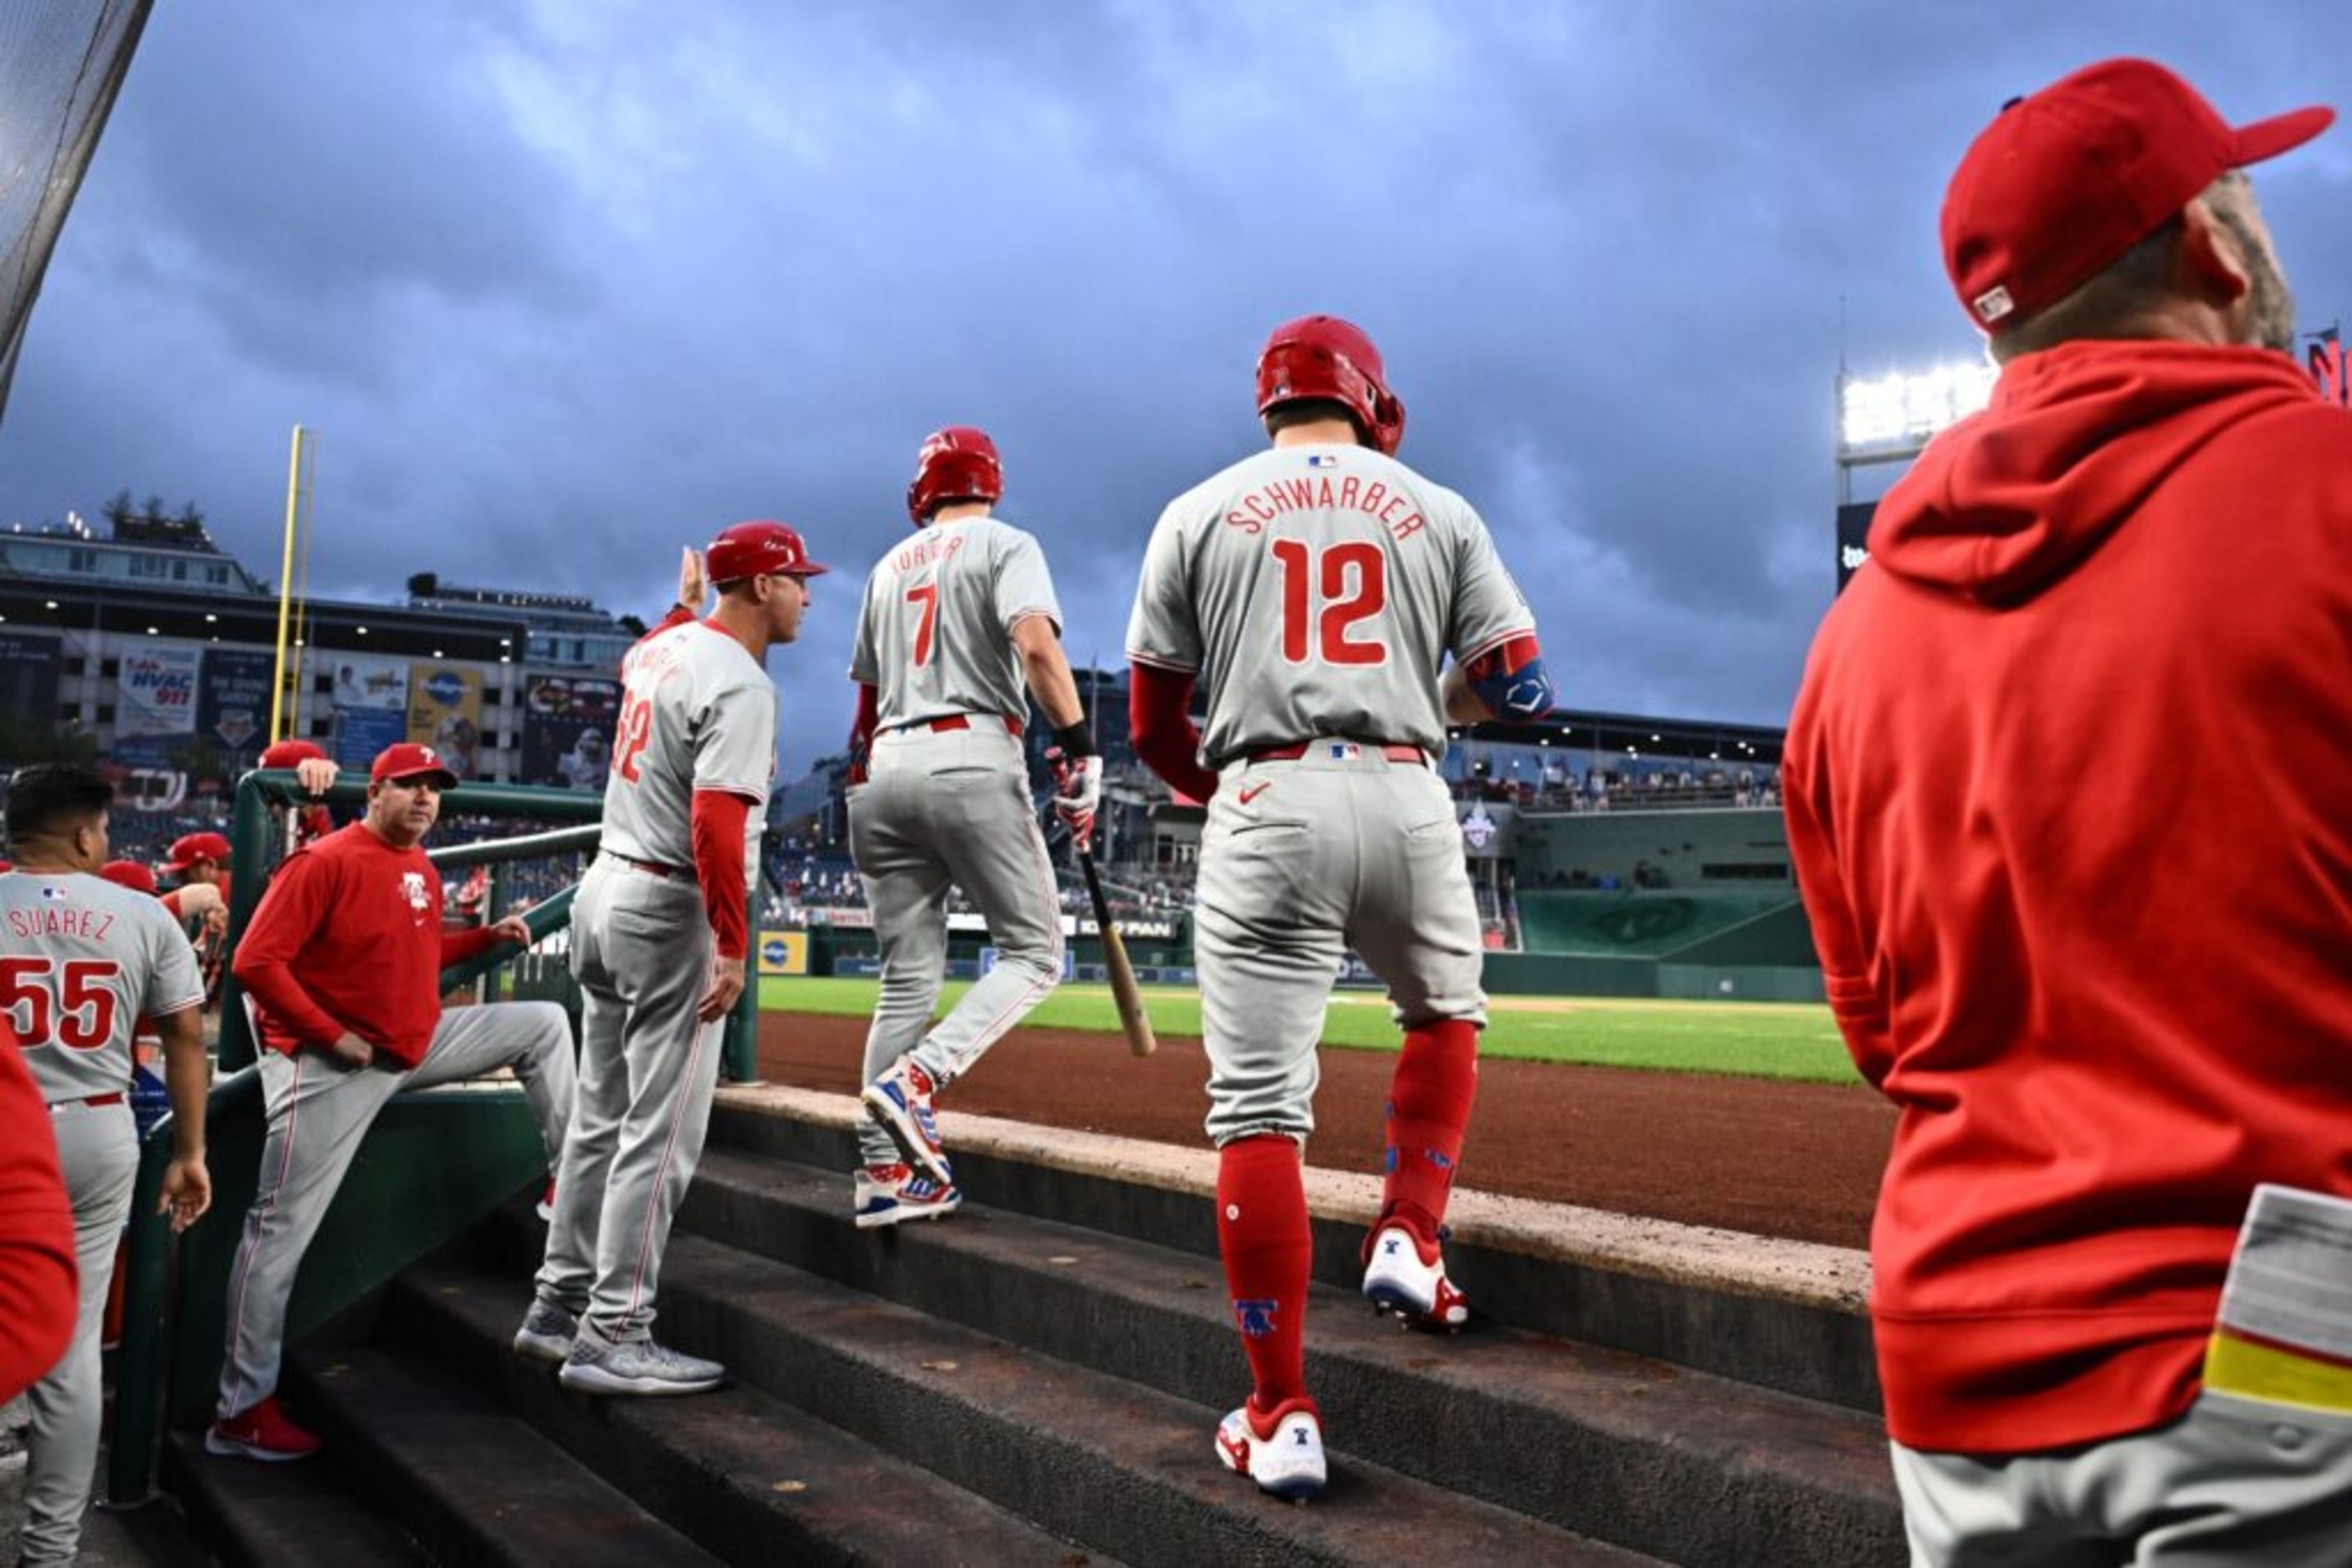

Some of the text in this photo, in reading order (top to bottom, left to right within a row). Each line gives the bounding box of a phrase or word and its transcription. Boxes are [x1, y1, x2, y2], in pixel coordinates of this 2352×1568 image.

[1226, 475, 1426, 541] SCHWARBER
[905, 581, 938, 667] 7
[1271, 537, 1388, 666] 12
[131, 672, 194, 689] HVAC
[154, 689, 192, 705] 911
[8, 910, 115, 942] SUAREZ
[0, 956, 119, 1051] 55
